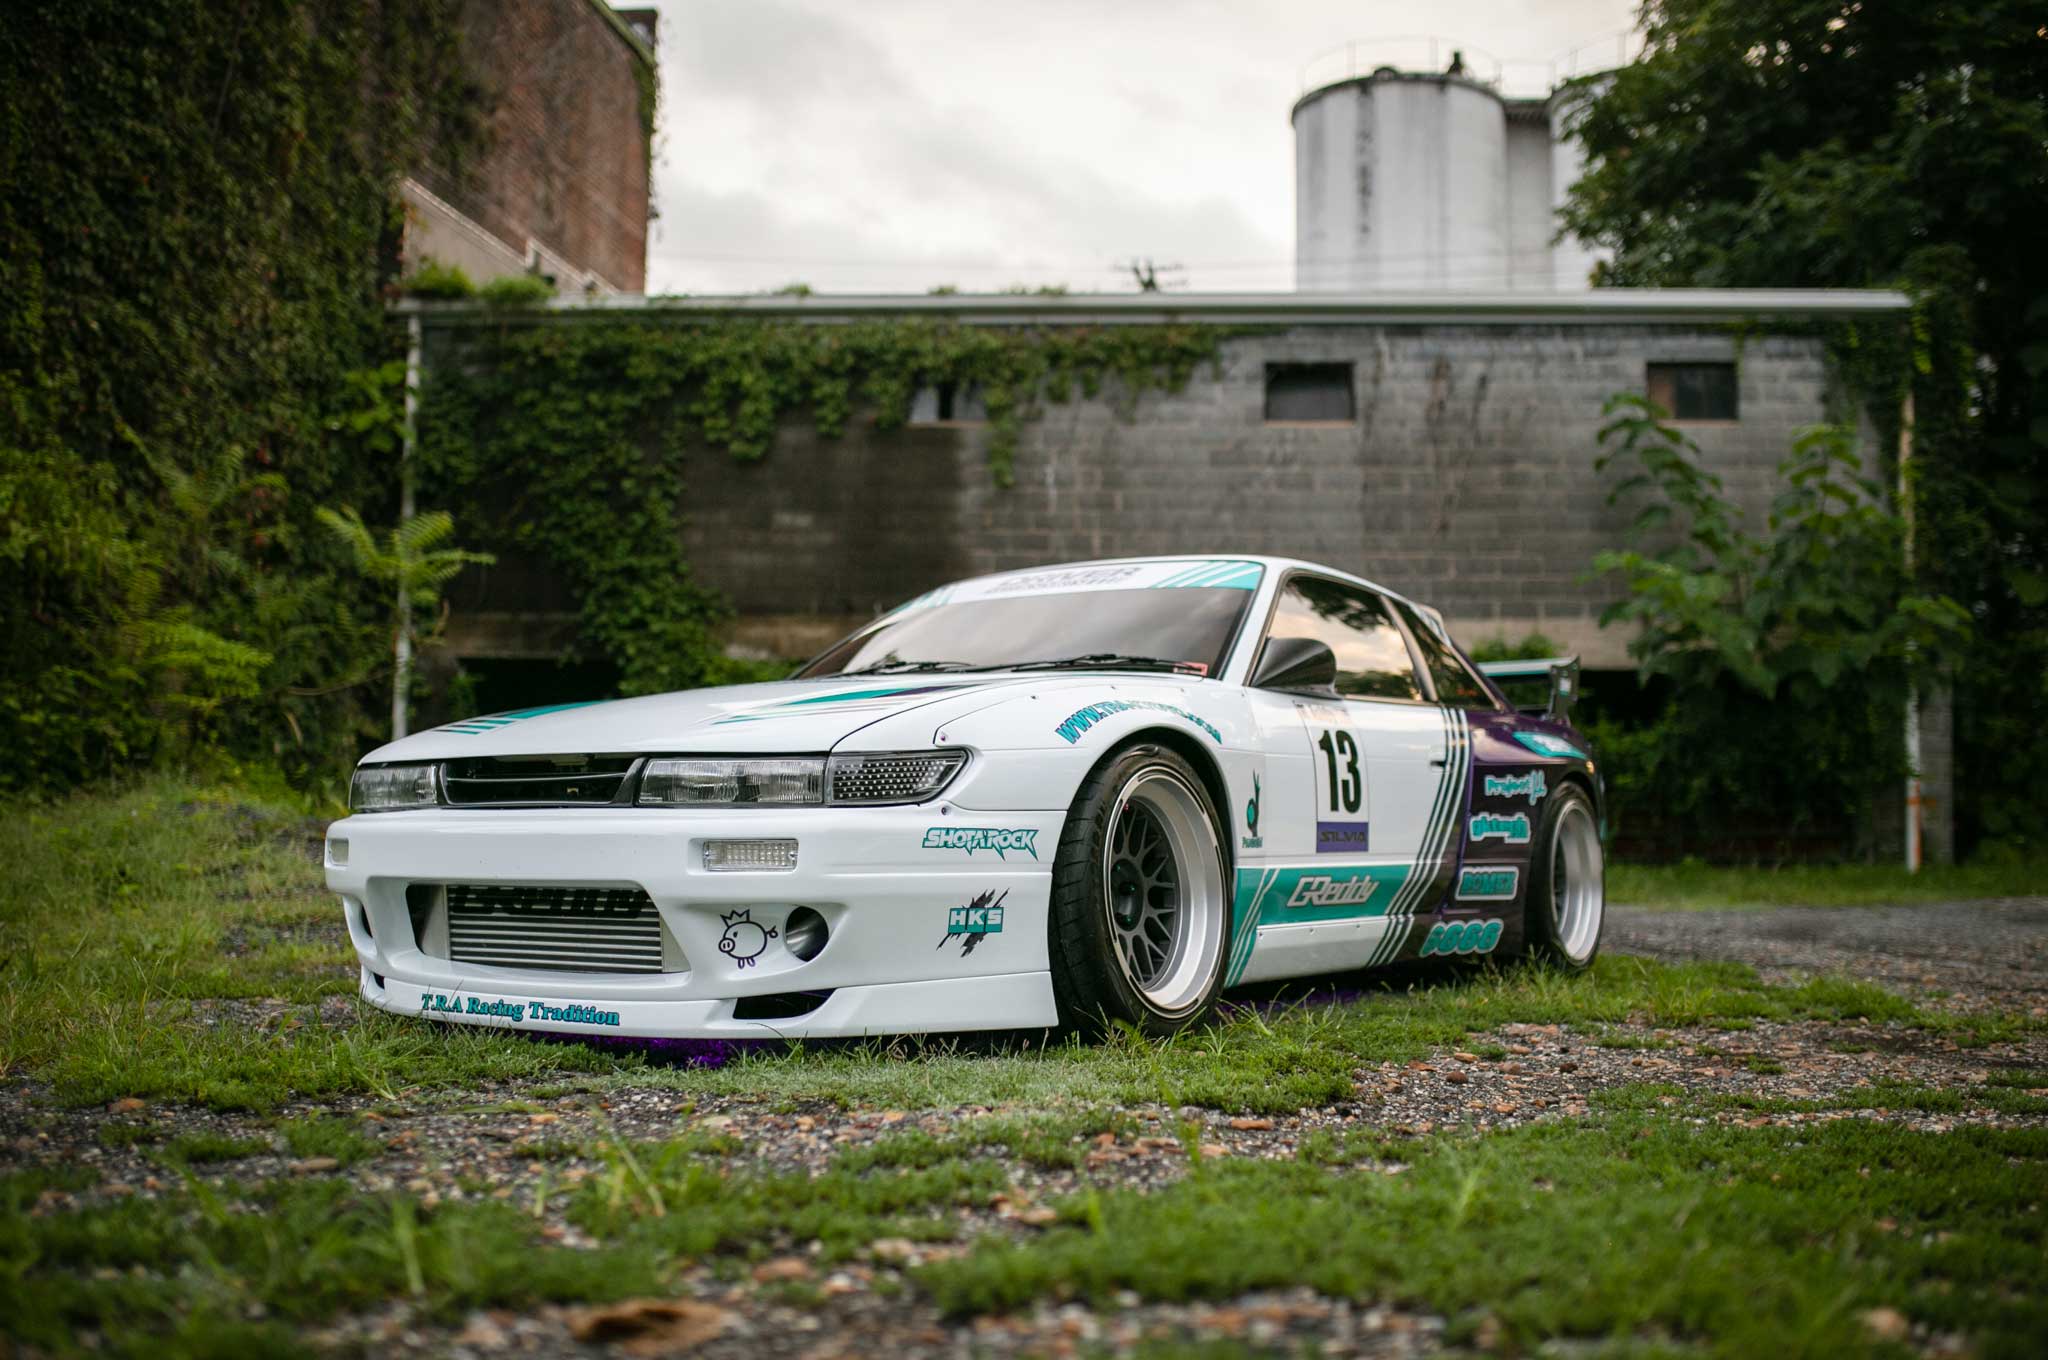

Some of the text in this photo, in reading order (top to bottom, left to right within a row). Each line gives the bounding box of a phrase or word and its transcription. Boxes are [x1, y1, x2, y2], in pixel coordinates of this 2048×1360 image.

[1318, 730, 1362, 814] 13
[1319, 830, 1366, 843] SILVIA
[1286, 875, 1380, 908] GReddy
[950, 909, 1002, 927] HKS
[466, 997, 525, 1021] Racing
[529, 1001, 620, 1026] Tradition
